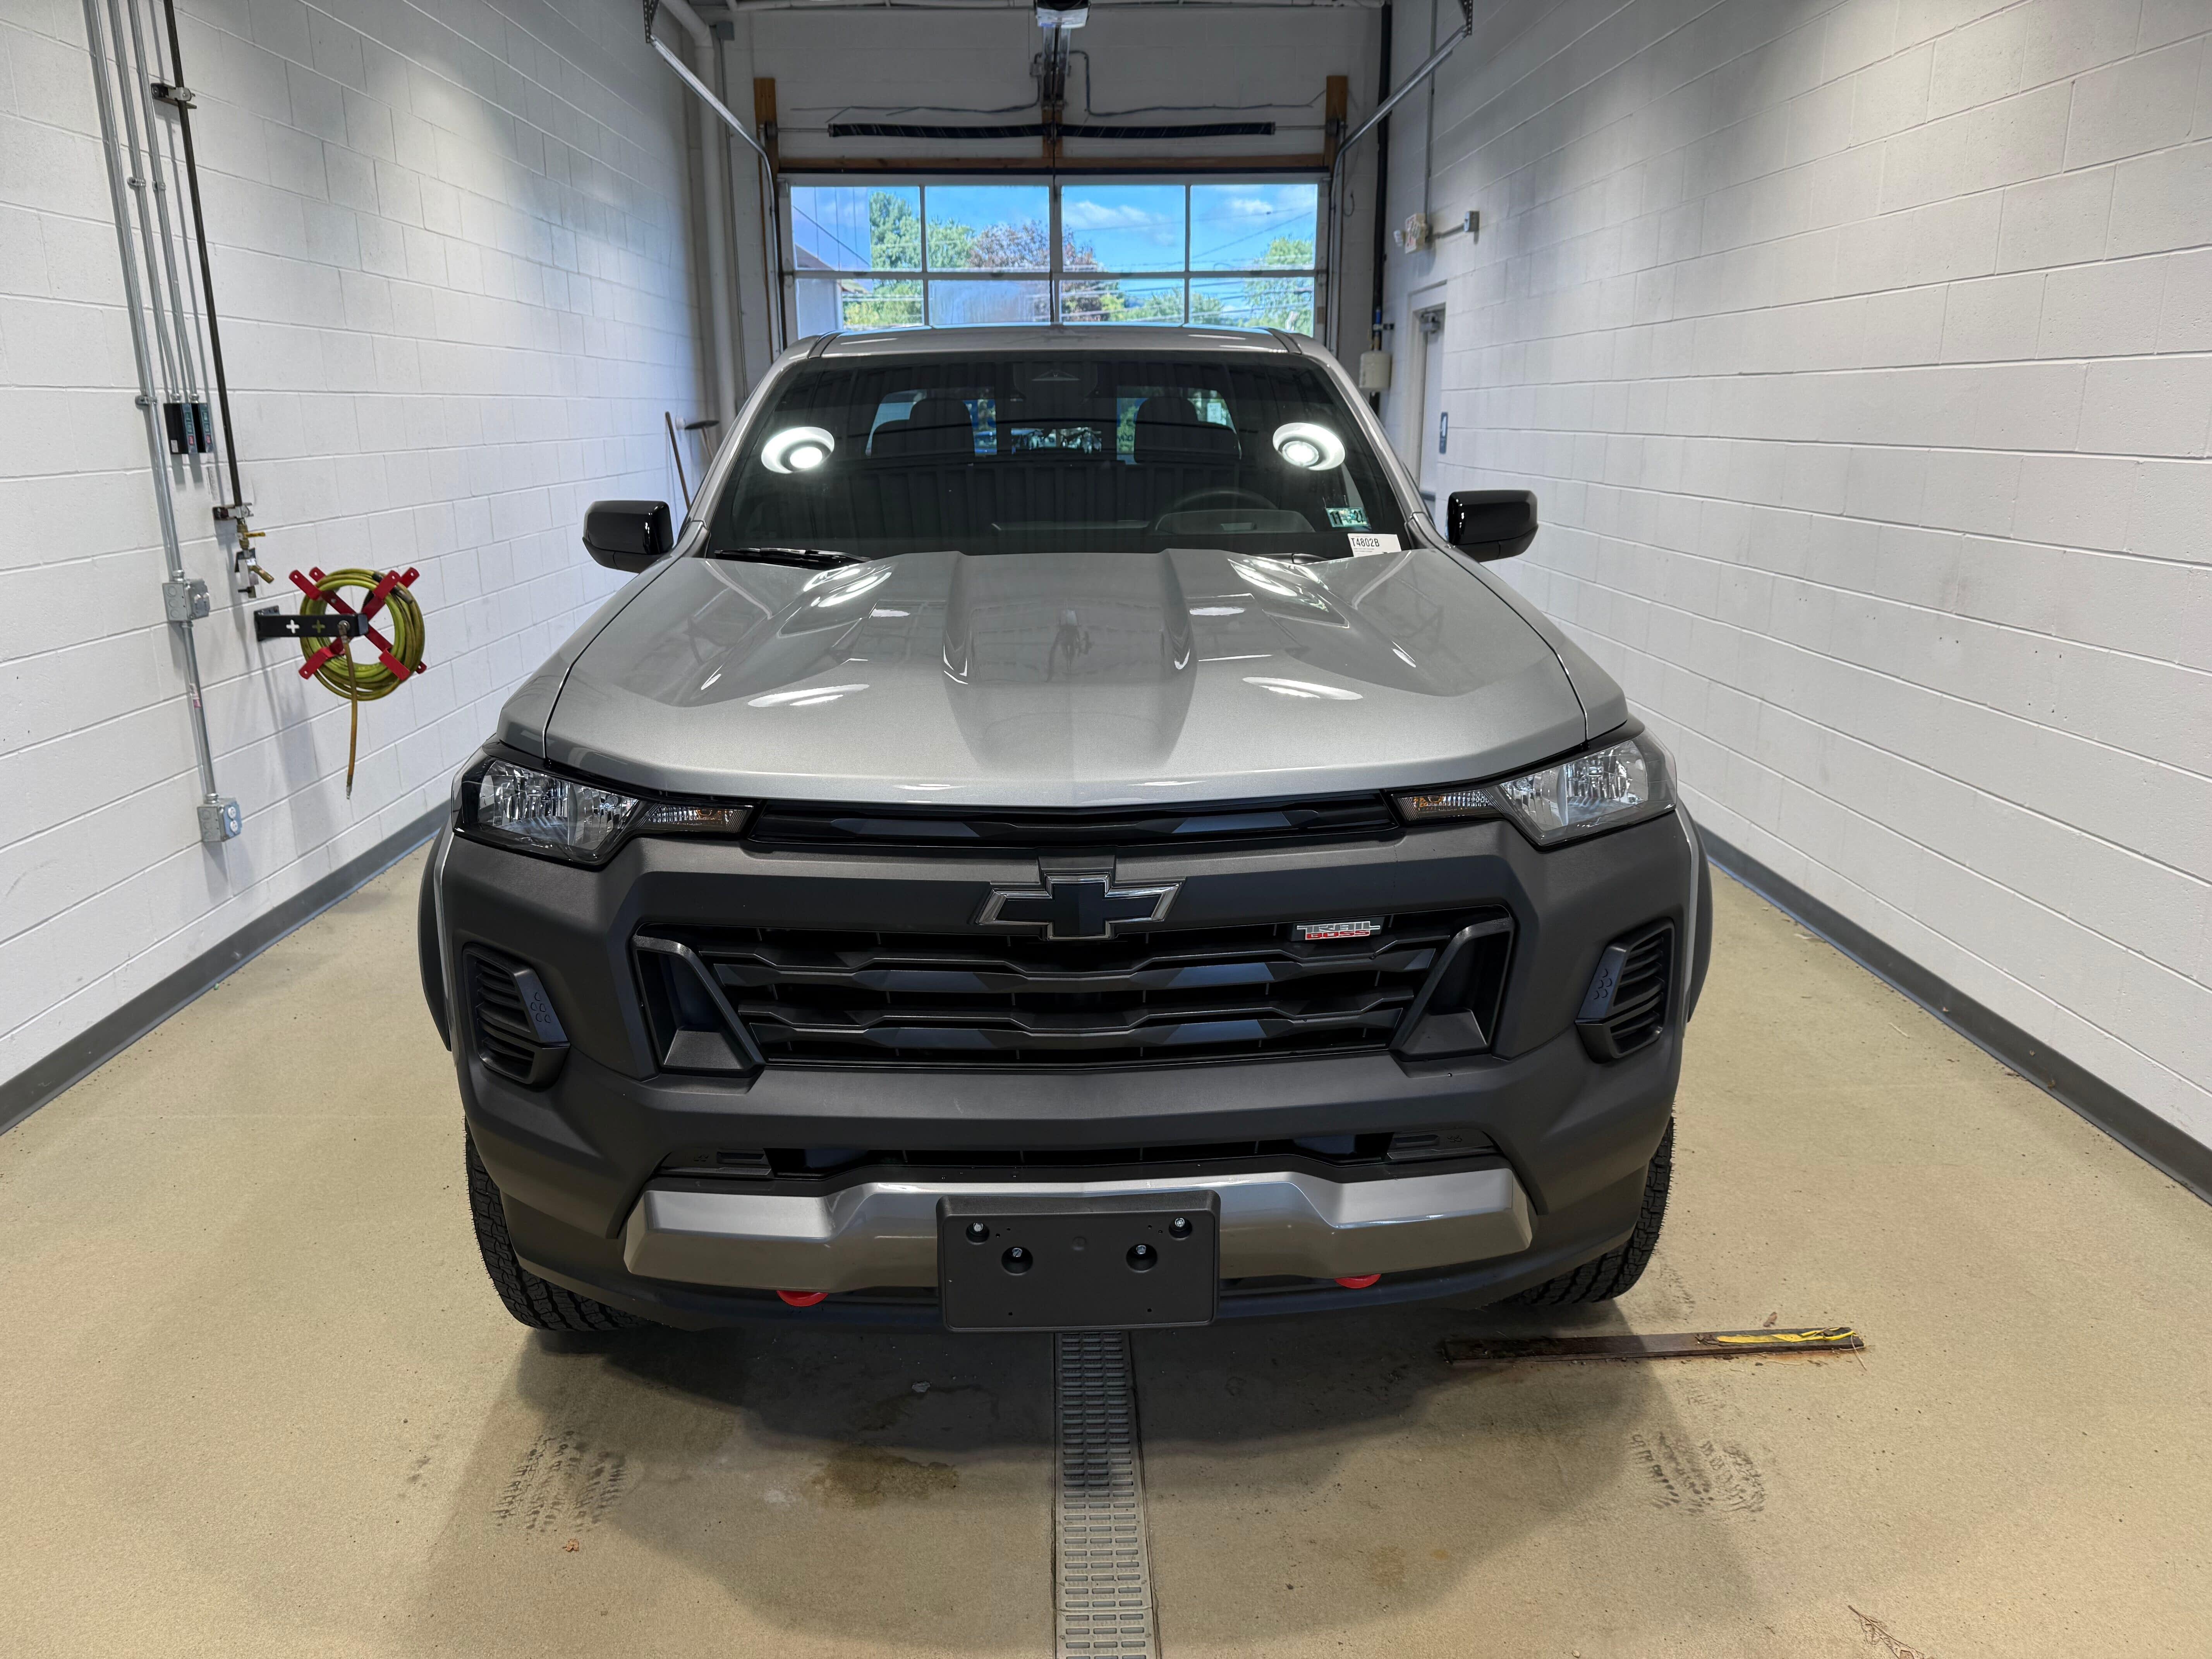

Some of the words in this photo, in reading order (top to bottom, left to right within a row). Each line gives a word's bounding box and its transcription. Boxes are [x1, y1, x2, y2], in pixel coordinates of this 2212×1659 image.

[1351, 538, 1379, 547] T4802B
[1297, 921, 1380, 933] TRAIL
[1305, 930, 1370, 940] BOSS
